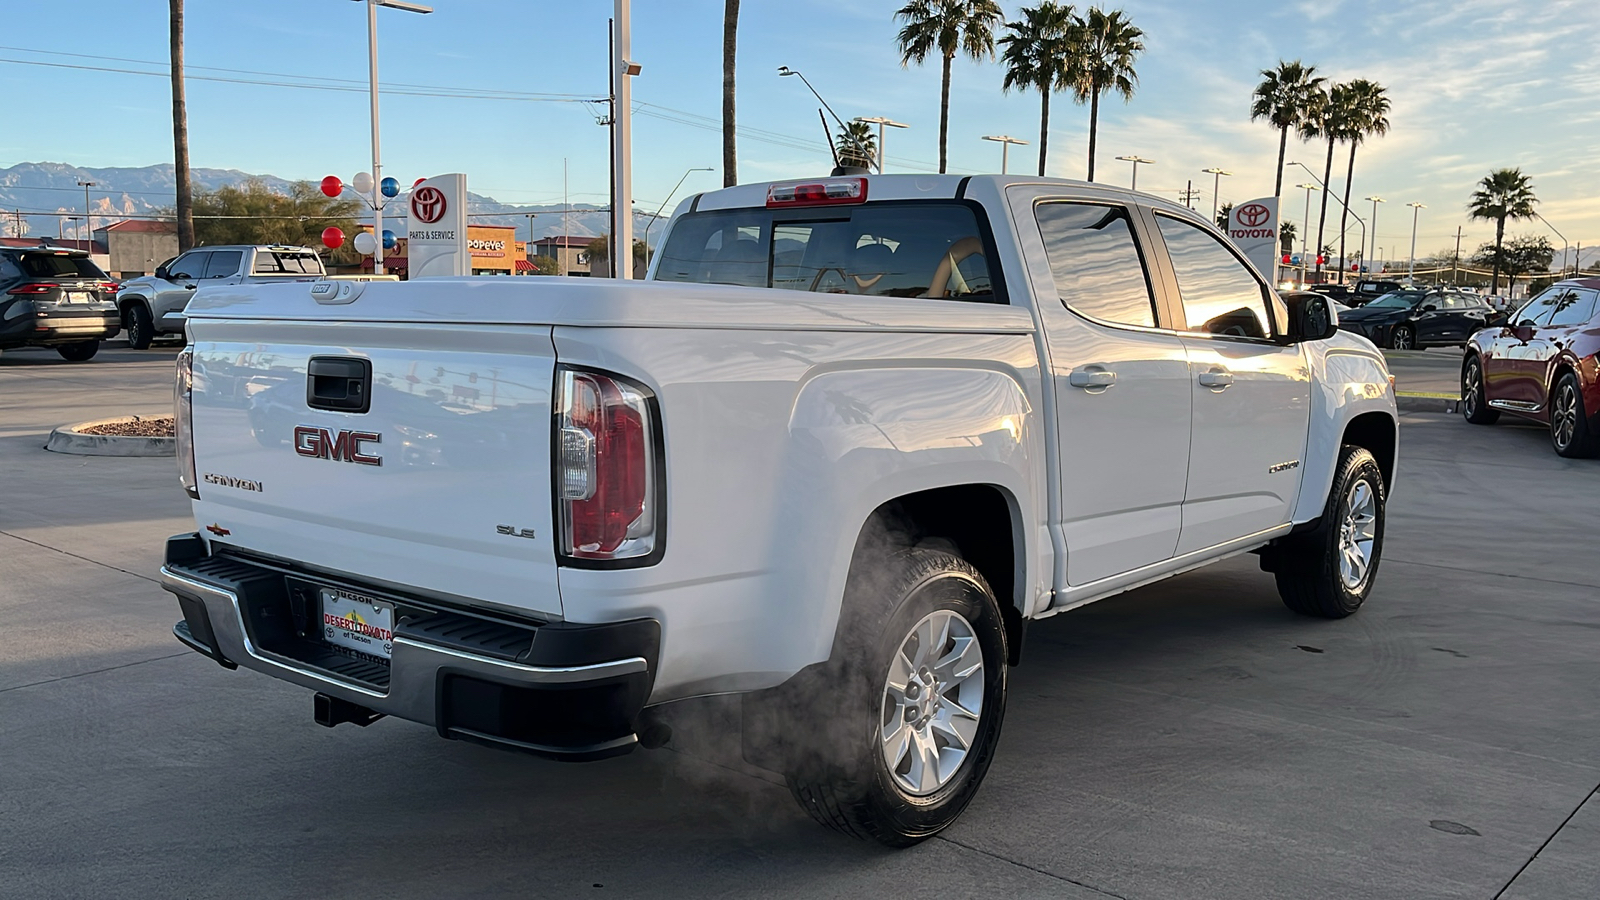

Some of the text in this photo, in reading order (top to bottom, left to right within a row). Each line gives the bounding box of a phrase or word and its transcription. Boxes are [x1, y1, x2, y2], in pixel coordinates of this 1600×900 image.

[409, 231, 455, 240] PARTS & SERVICE
[1230, 229, 1274, 238] TOYOTA
[294, 425, 383, 467] GMC
[204, 473, 263, 493] CANYON
[496, 525, 536, 539] SLE
[335, 590, 373, 605] TUCSON
[324, 613, 393, 643] DESERT TOYOTA
[351, 633, 372, 645] Tucson
